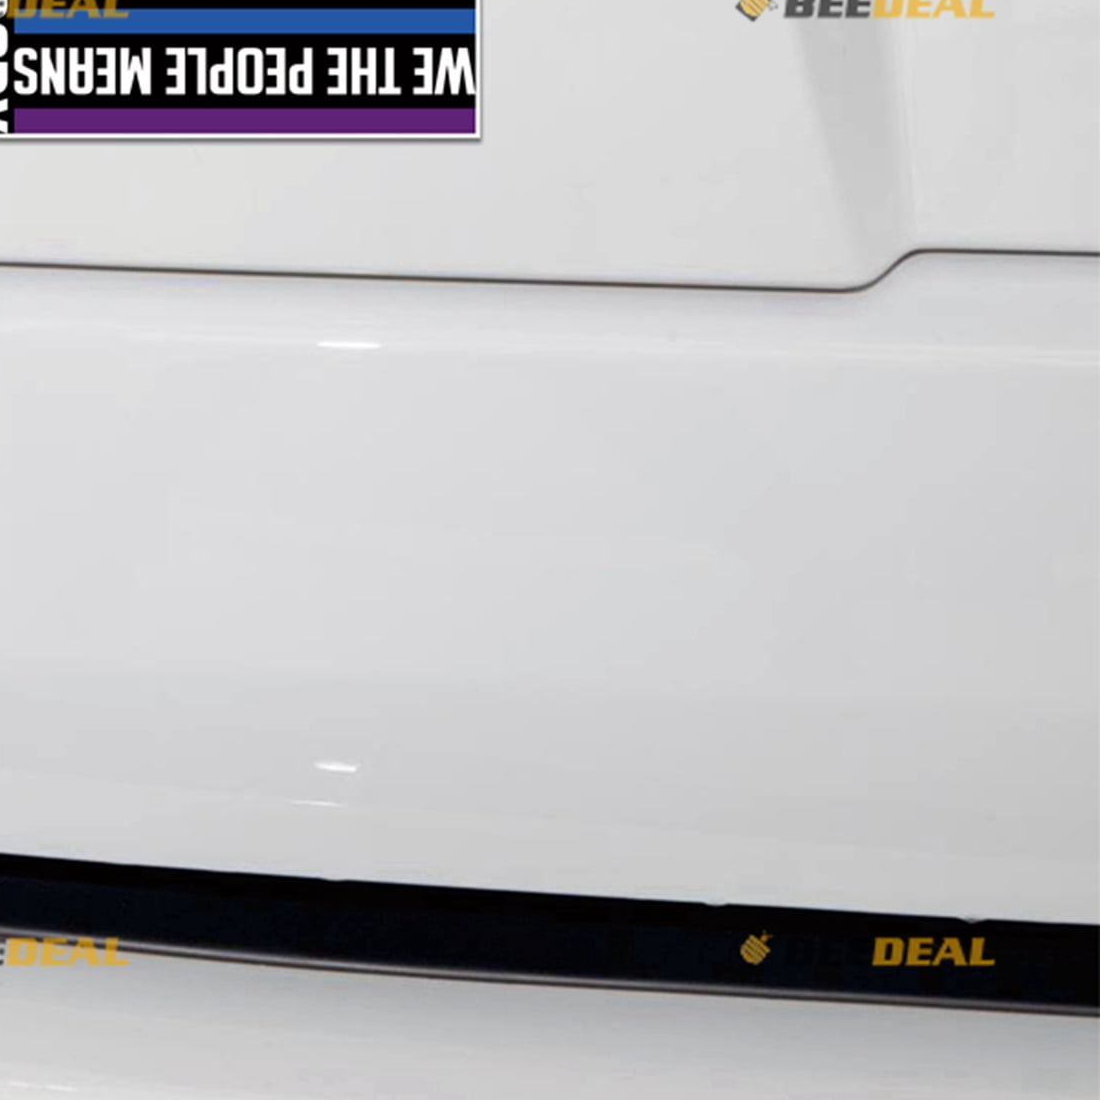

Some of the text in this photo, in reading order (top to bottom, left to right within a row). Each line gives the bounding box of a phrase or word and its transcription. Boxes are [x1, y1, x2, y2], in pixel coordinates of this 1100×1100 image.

[13, 47, 477, 95] WE THE PEOPLE MEANS
